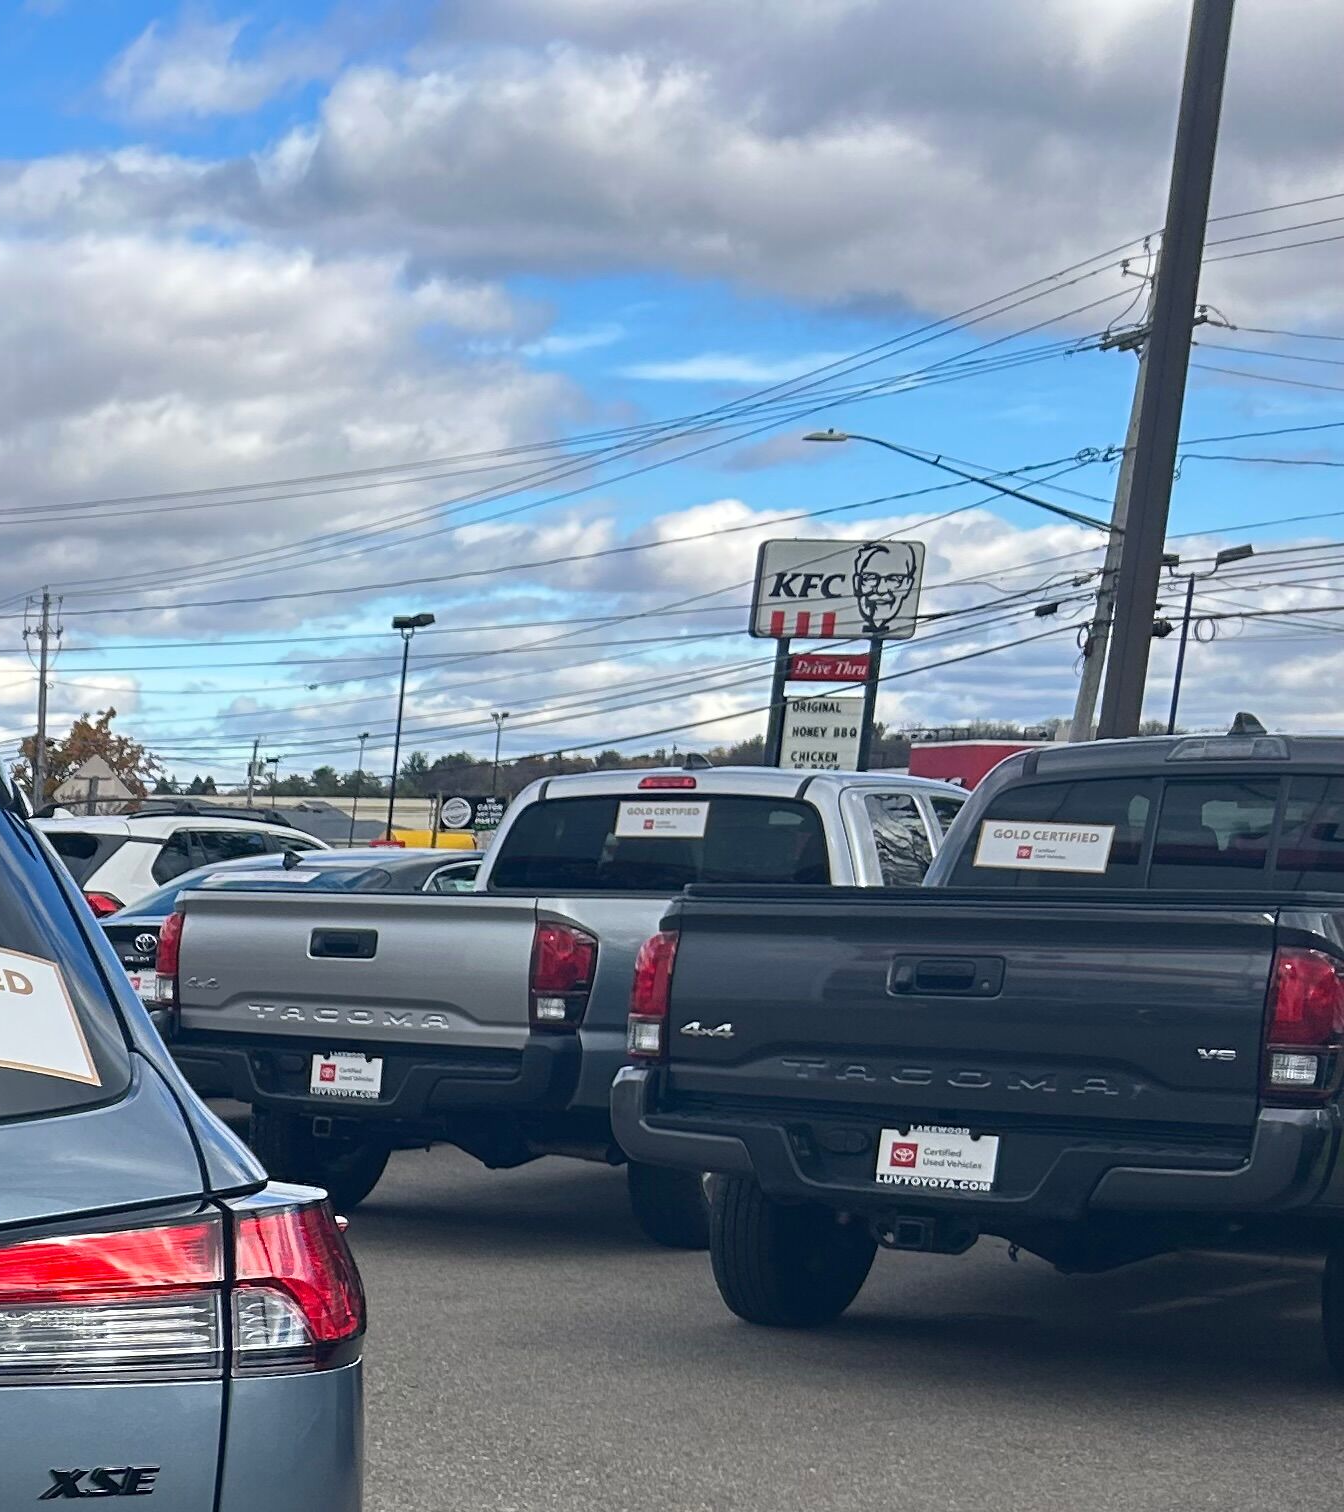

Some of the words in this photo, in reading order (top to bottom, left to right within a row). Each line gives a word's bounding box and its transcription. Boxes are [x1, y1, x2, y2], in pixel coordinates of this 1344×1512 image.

[769, 573, 846, 598] KFC
[794, 660, 831, 675] Drive
[835, 660, 867, 675] Thru
[792, 701, 842, 713] ORIGINAL
[792, 726, 827, 738] HONEY
[833, 727, 857, 738] BBQ
[791, 751, 838, 762] CHICKEN
[626, 807, 652, 816] GOLD
[654, 807, 700, 816] CERTIFIED
[993, 828, 1030, 839] GOLD
[1033, 830, 1100, 843] CERTIFIED
[247, 1003, 450, 1030] TACOMA
[781, 1058, 1119, 1095] TACOMA
[909, 1125, 970, 1135] LAKEWOOD
[923, 1147, 962, 1158] Certified
[922, 1158, 945, 1168] Used
[946, 1159, 982, 1169] Vehicles
[876, 1174, 991, 1191] LUVTOYOTA.COM
[36, 1464, 161, 1500] XSE
